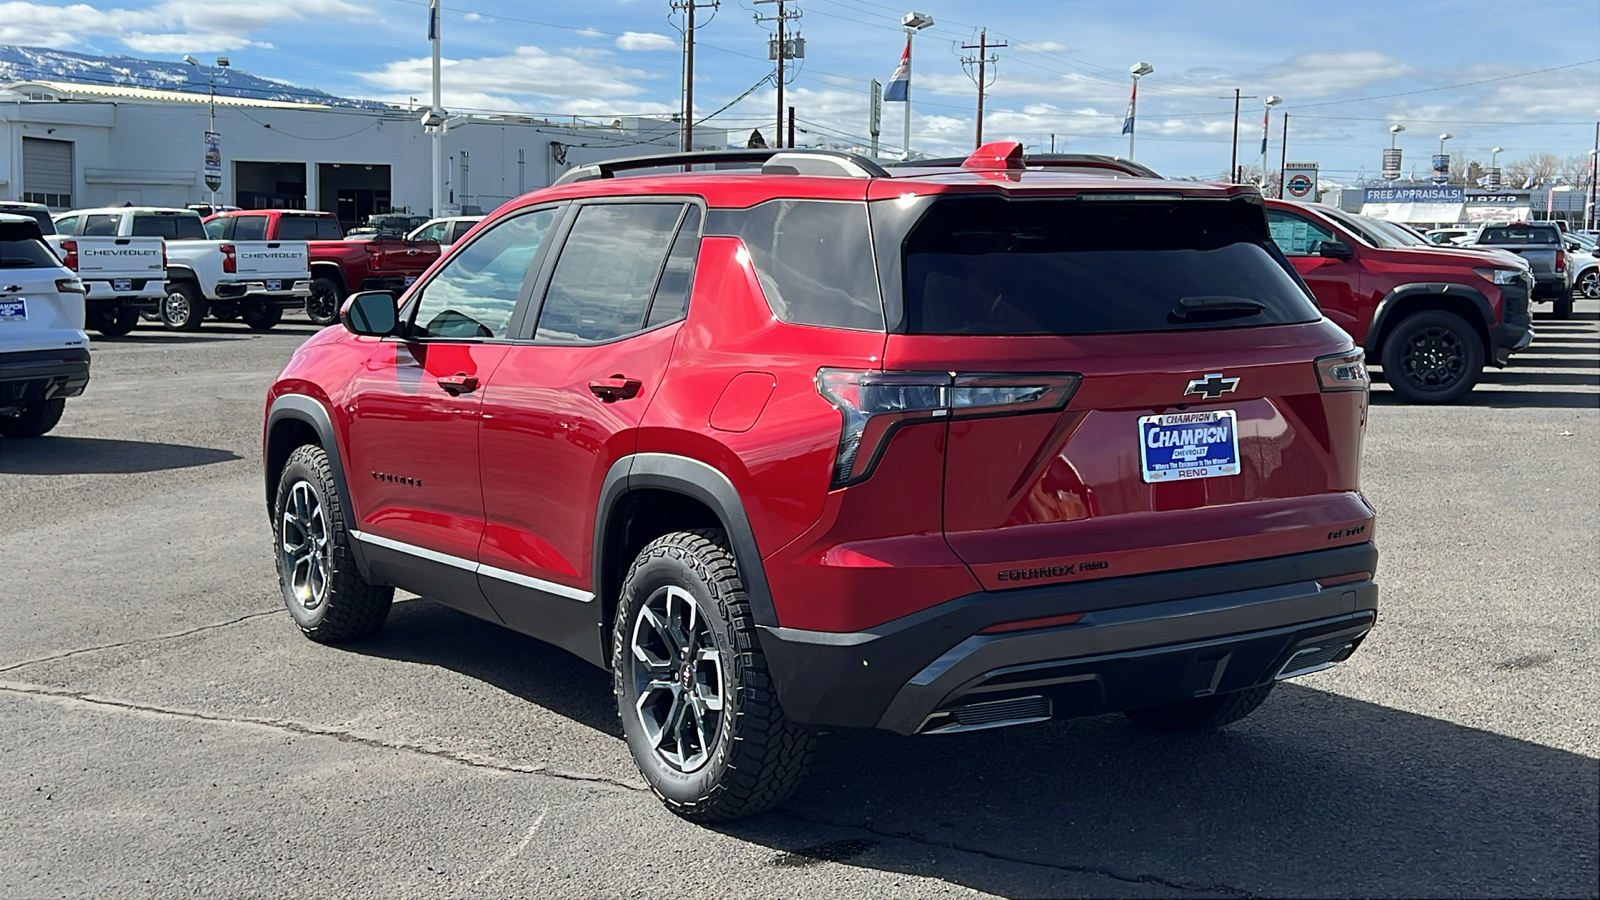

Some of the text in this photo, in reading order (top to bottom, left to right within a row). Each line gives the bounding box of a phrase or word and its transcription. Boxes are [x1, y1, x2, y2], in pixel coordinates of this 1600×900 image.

[1367, 189, 1461, 199] FREE APPRAISALS!
[1166, 413, 1211, 424] CHAMPION
[1147, 426, 1228, 448] CHAMPION
[1174, 448, 1206, 457] CHEVROLET
[1178, 468, 1208, 478] RENO
[997, 564, 1076, 581] EQUINOX
